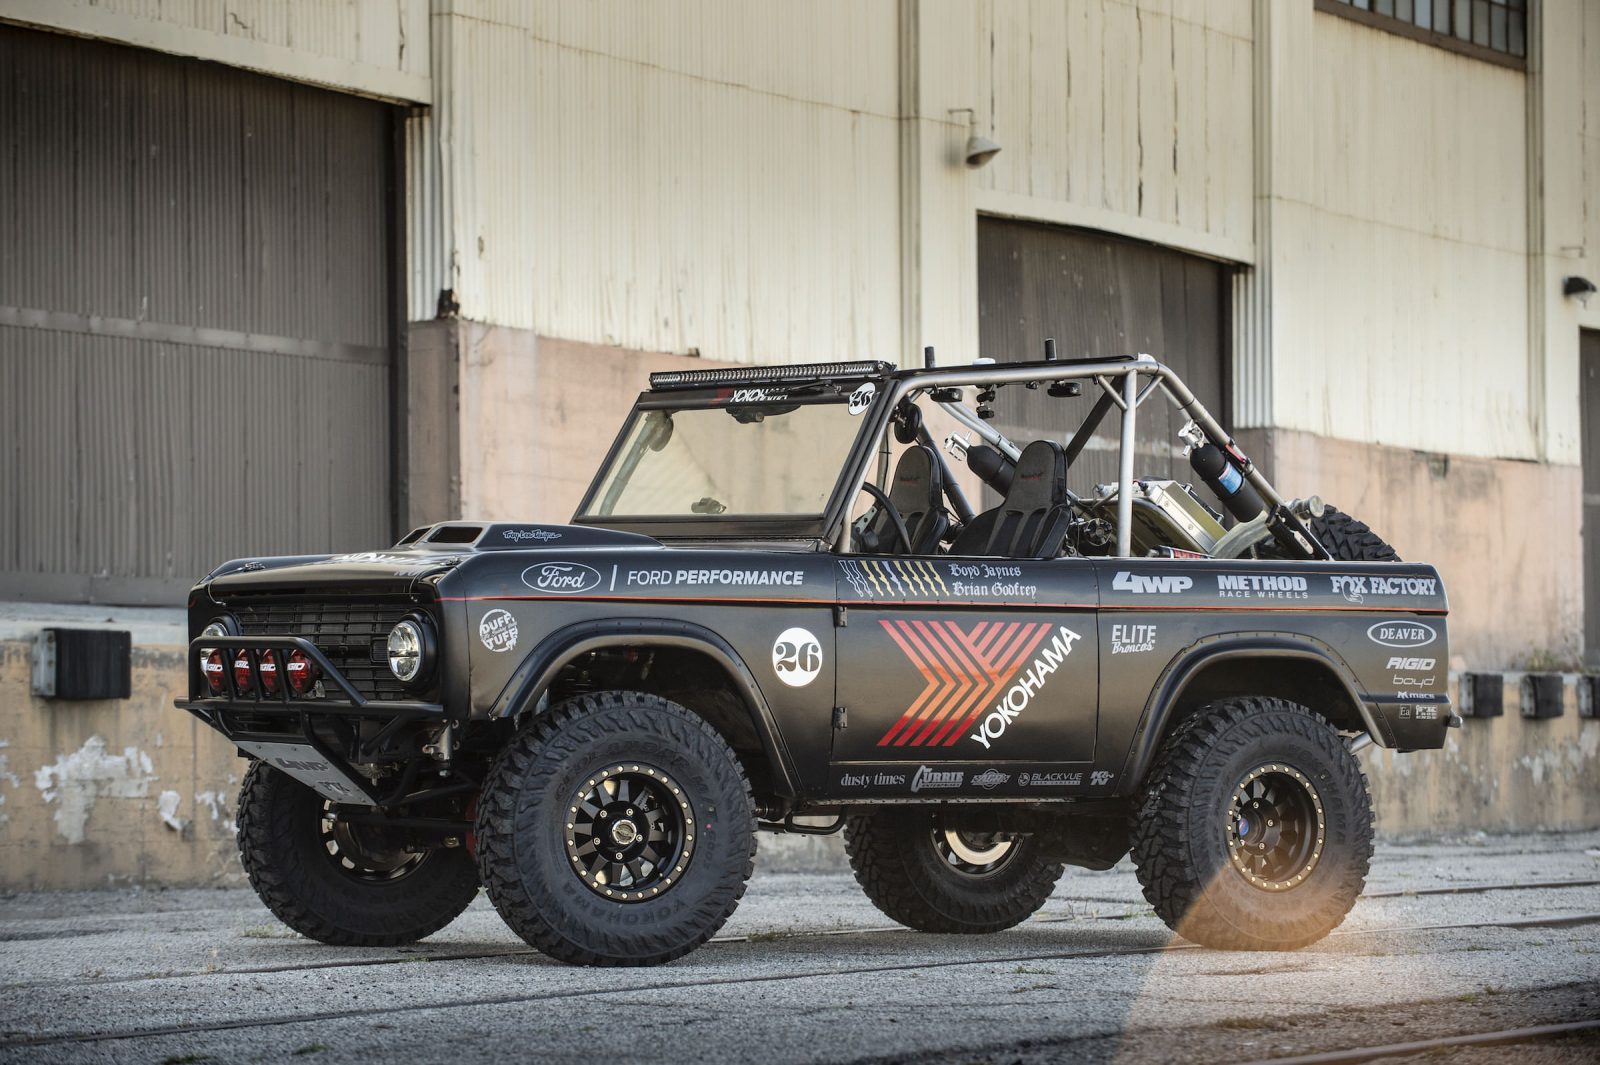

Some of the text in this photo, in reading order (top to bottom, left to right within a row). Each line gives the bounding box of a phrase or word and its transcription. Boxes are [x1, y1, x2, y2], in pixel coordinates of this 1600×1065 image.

[850, 390, 874, 407] 26
[536, 566, 585, 588] Ford
[627, 570, 804, 586] FORD PERFORMANCE
[948, 563, 1022, 580] Boyd Jaynes
[952, 581, 1037, 599] Brian Godfrey
[1112, 571, 1193, 593] 4WP
[1217, 575, 1308, 591] METHOD
[1330, 575, 1436, 604] FOX FACTORY
[1219, 590, 1309, 599] RACE WHEELS
[1112, 624, 1157, 644] ELITE
[1379, 628, 1425, 640] DEAVER
[775, 641, 820, 673] 26
[1386, 657, 1436, 670] RIGID
[970, 626, 1082, 749] YOKOHAMA
[1392, 674, 1436, 688] boyd
[840, 773, 871, 789] dusty
[874, 772, 905, 786] times
[911, 765, 964, 793] CURRIE
[1031, 772, 1083, 781] BLACKVUE
